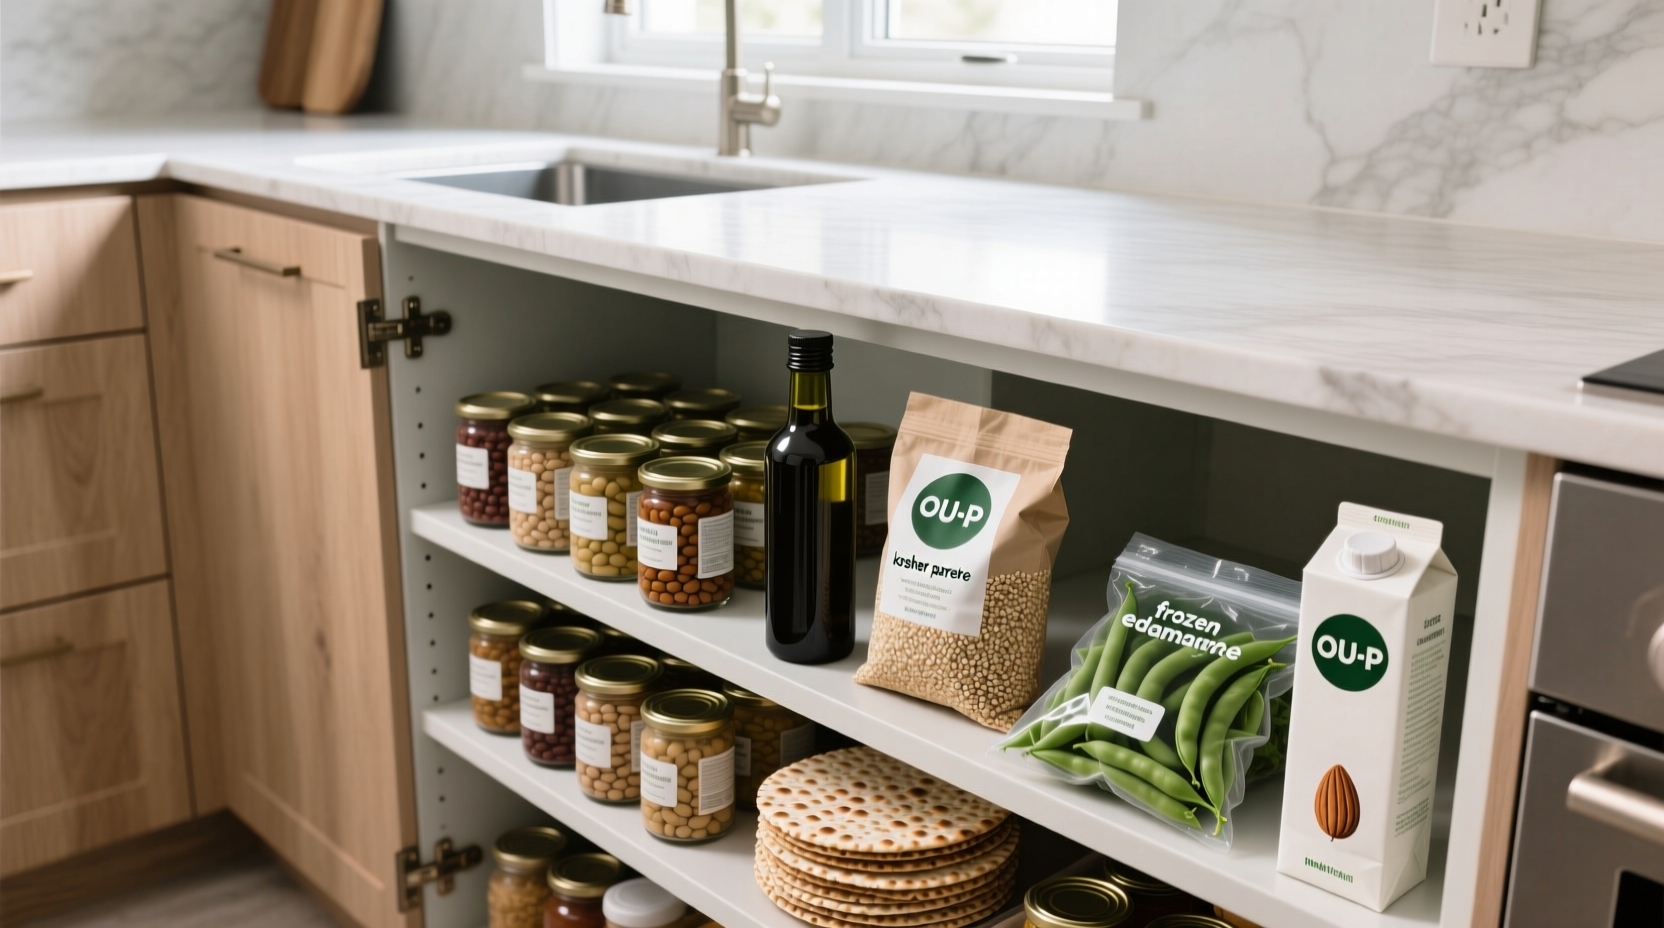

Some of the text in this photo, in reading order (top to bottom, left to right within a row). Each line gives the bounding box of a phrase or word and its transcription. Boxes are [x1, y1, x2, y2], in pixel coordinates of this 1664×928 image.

[919, 495, 984, 529] OU-P
[1154, 600, 1221, 637] frozen
[1316, 634, 1384, 671] OU-P
